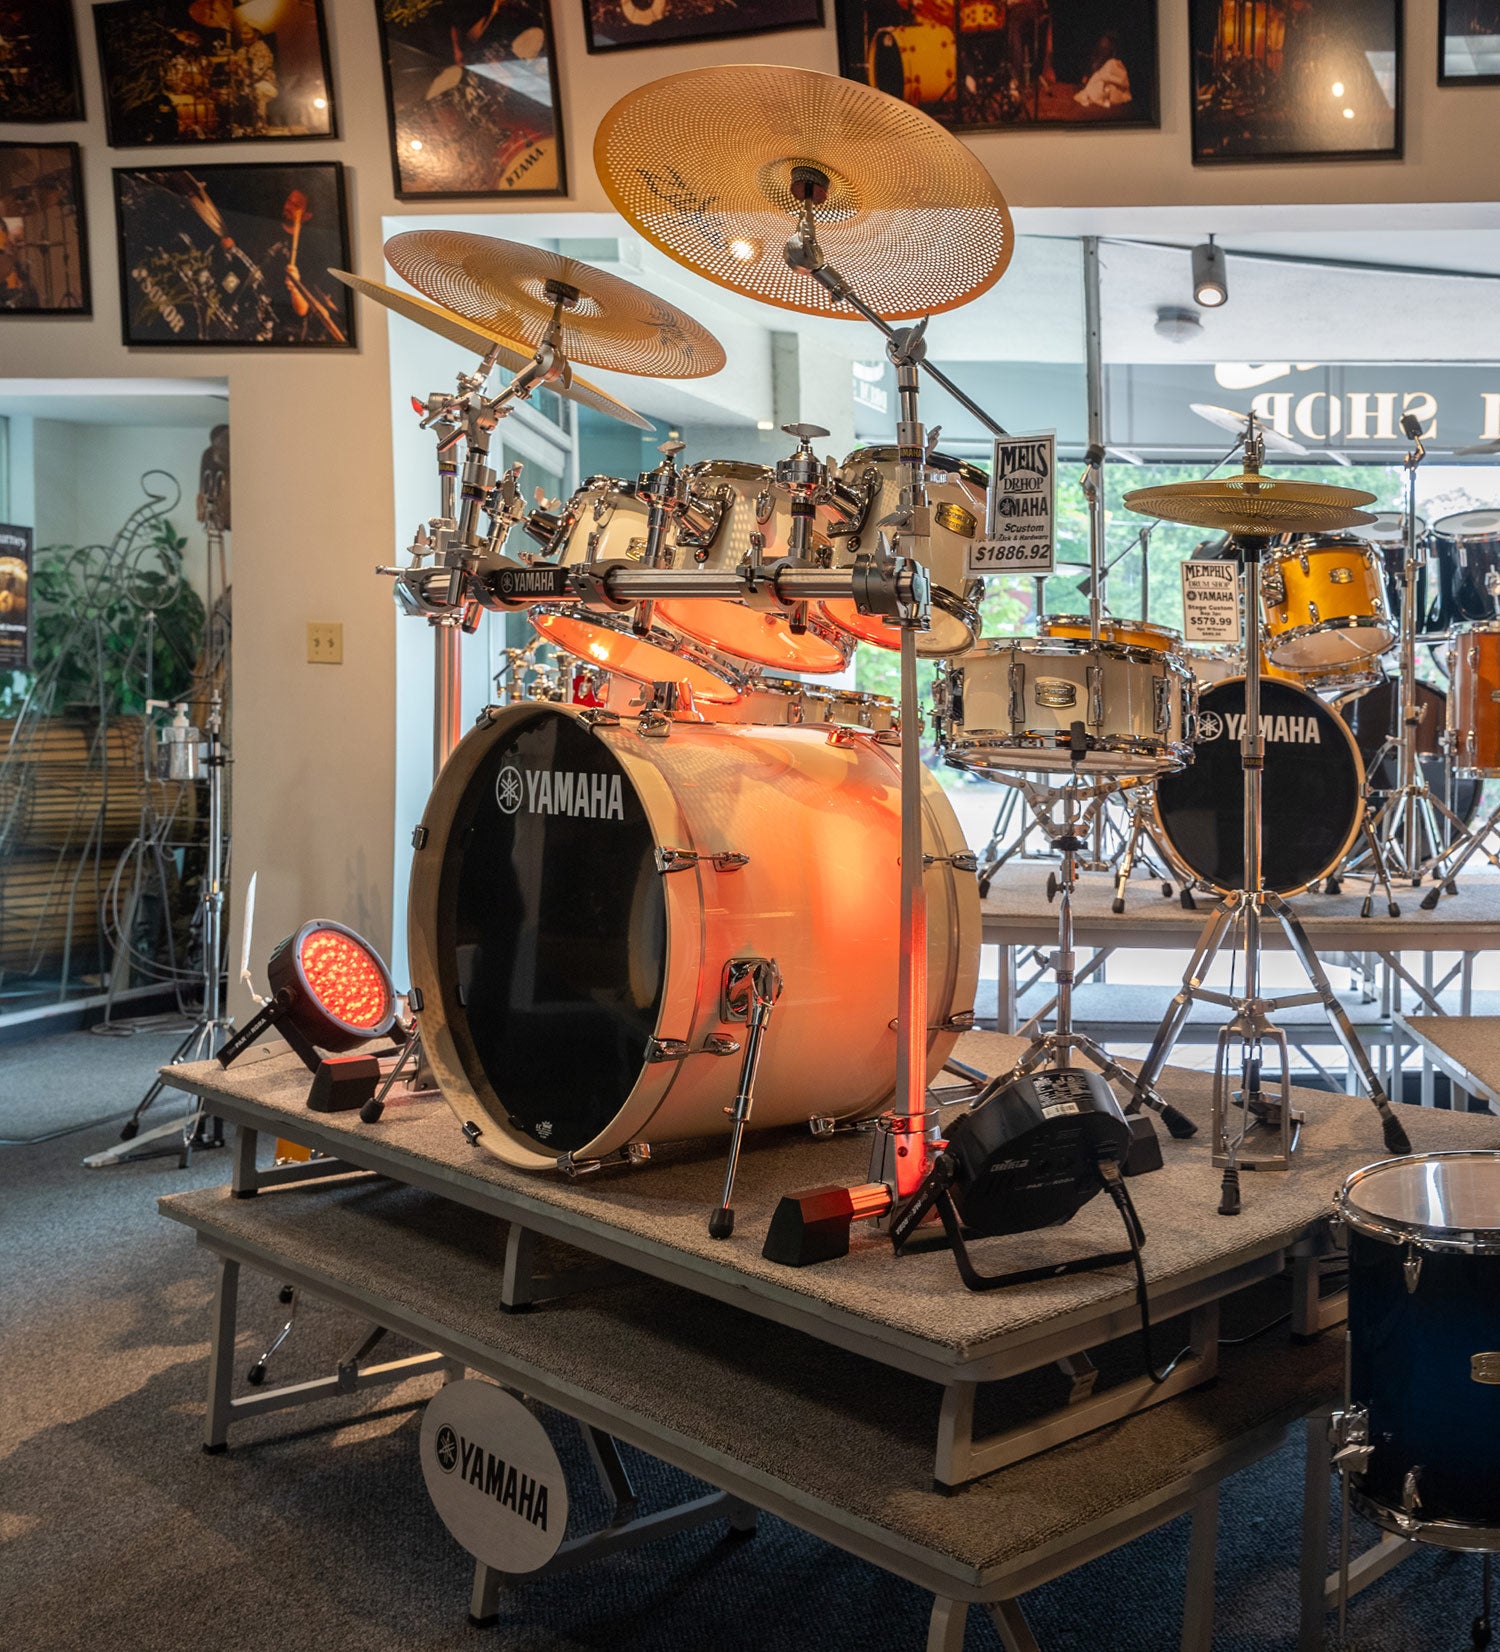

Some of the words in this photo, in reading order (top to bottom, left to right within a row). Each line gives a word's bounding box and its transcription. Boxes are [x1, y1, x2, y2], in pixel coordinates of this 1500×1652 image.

[975, 544, 1051, 563] $1886.92
[514, 572, 554, 592] YAMAHA
[1184, 565, 1233, 582] MEMPHIS
[1197, 591, 1234, 602] YAMAHA
[1190, 616, 1232, 626] $579.99
[525, 769, 625, 820] YAMAHA
[460, 1436, 549, 1532] YAMAHA
